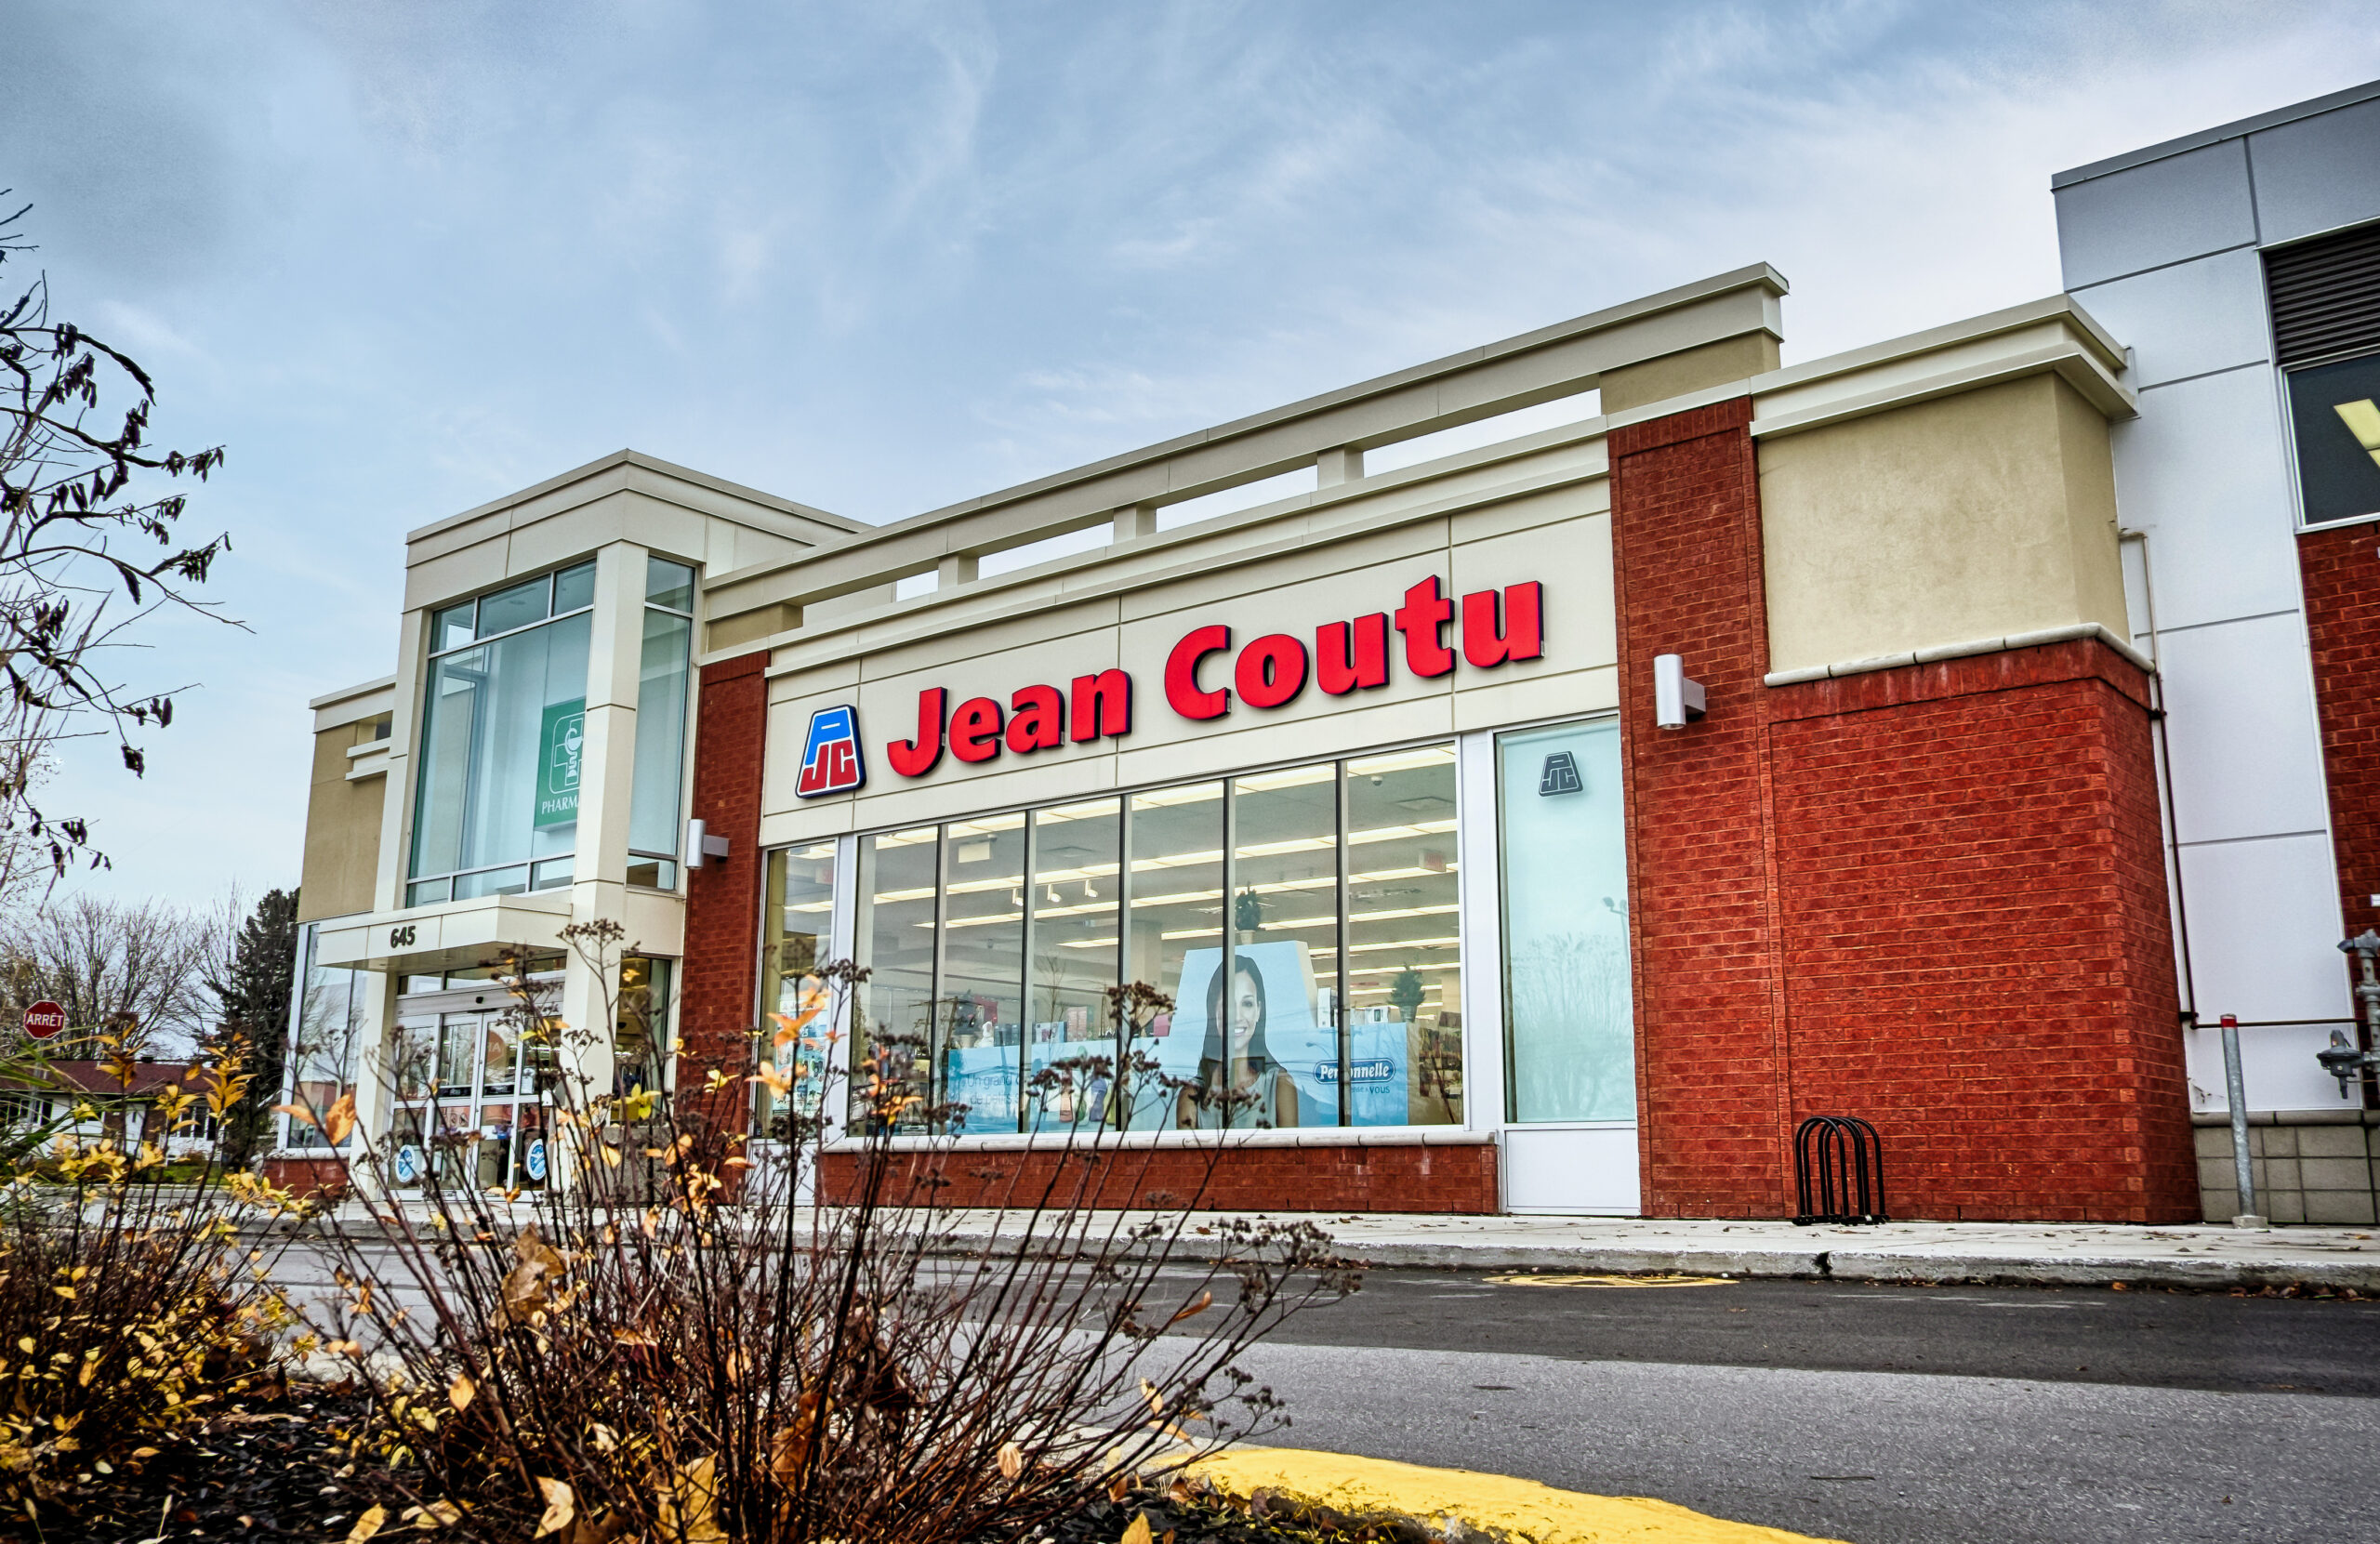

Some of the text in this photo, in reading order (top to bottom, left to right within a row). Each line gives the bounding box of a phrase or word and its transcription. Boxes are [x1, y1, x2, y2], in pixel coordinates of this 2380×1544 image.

[887, 574, 1544, 777] Jean Coutu
[390, 925, 416, 948] 645
[26, 1012, 63, 1026] ARRÊT
[1320, 1062, 1389, 1079] Pernnelle
